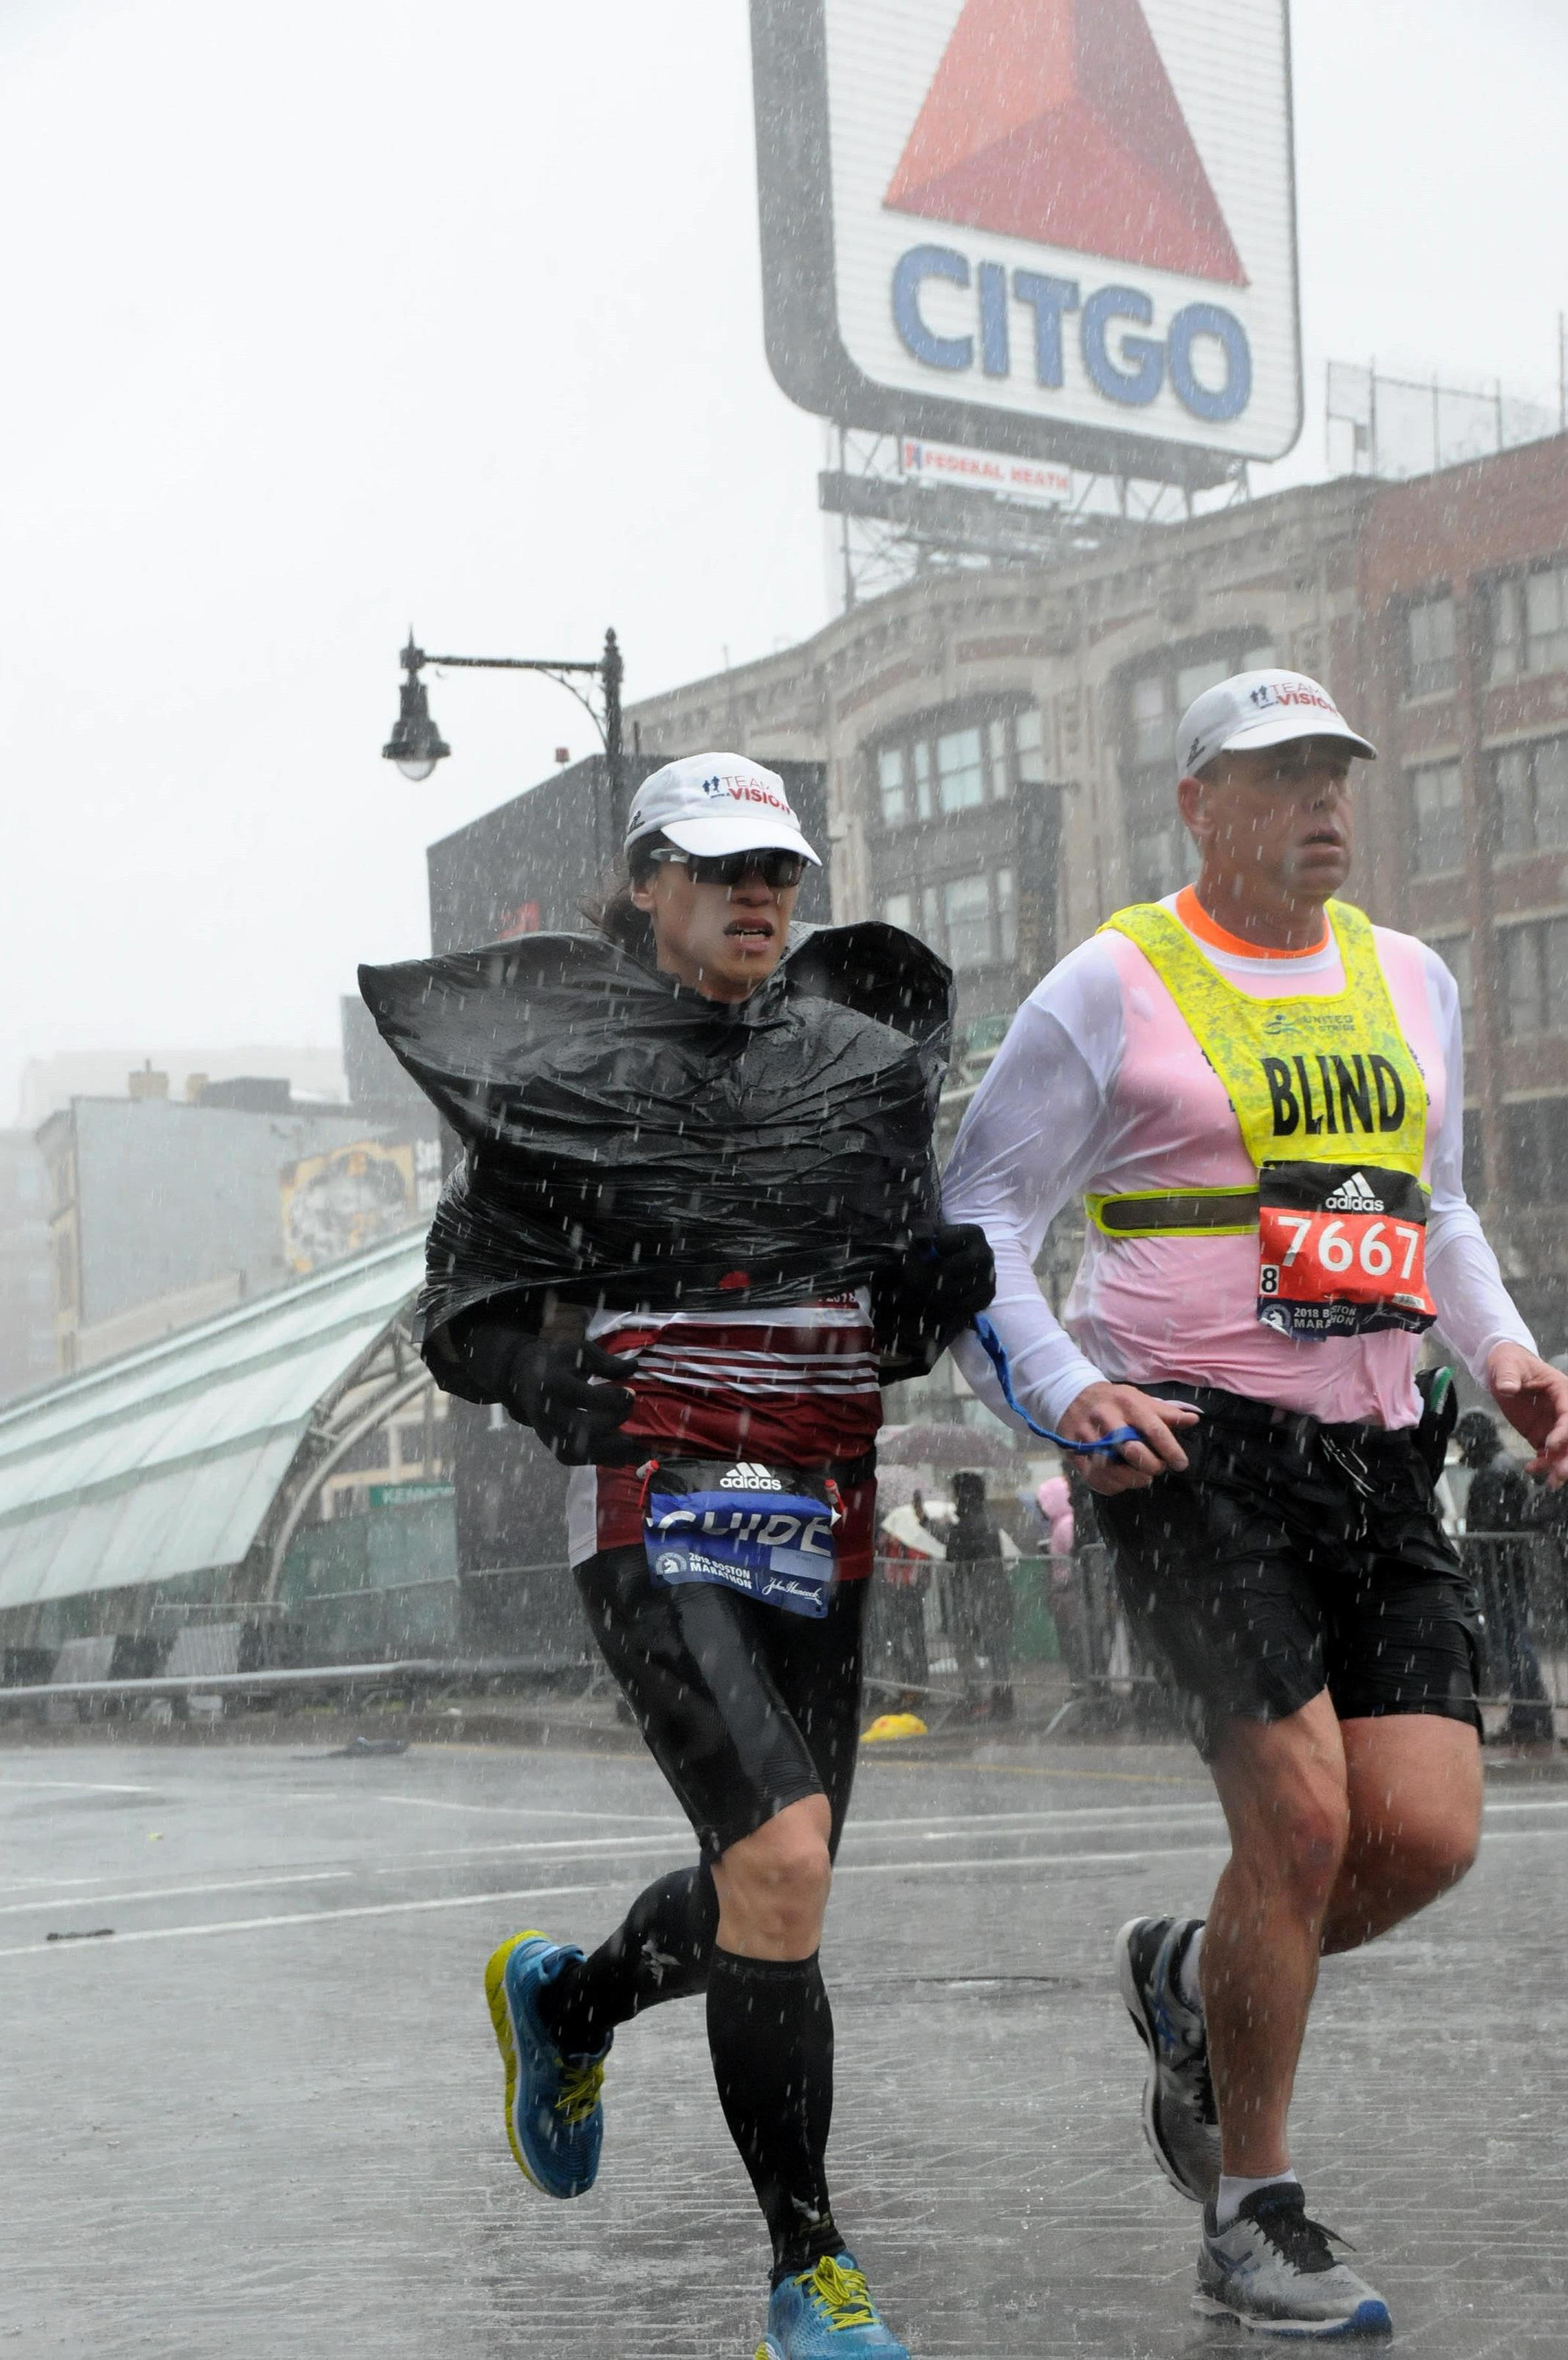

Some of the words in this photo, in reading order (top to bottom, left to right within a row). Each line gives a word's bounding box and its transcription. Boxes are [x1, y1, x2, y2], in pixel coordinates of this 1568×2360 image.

[892, 243, 1253, 423] CITGO
[925, 451, 1004, 479] FEDERAL
[1011, 466, 1069, 489] HEATH
[1259, 1054, 1405, 1136] BLIND
[1325, 1195, 1384, 1213] adidas
[1278, 1216, 1419, 1279] 7667
[1262, 1268, 1277, 1292] 8
[1294, 1308, 1319, 1317] 2018
[1323, 1305, 1356, 1318] BSTON
[1294, 1315, 1355, 1329] MARAHON
[720, 1475, 782, 1490] adidas
[689, 1552, 710, 1565] 2018
[691, 1562, 752, 1590] MARATHON
